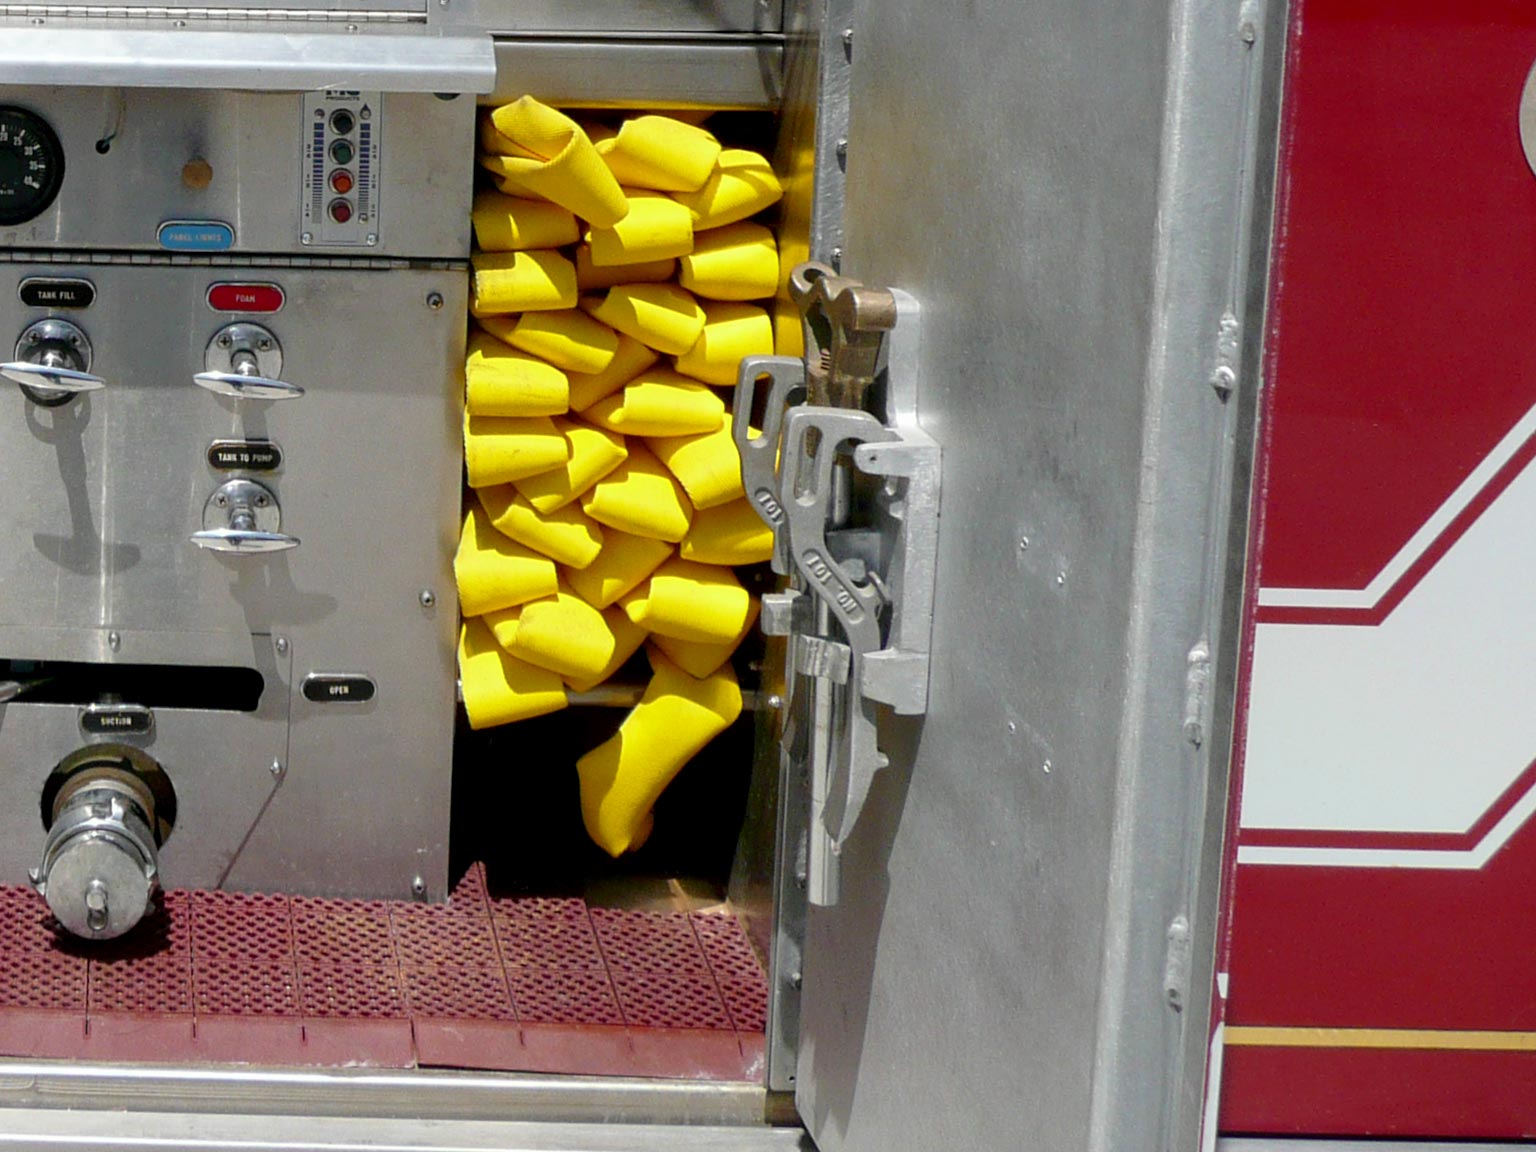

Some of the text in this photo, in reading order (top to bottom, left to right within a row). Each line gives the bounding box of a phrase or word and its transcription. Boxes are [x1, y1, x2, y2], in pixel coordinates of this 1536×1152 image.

[0, 132, 8, 141] 20
[13, 136, 22, 146] 25
[24, 146, 33, 156] 30
[29, 160, 38, 170] 35
[37, 290, 75, 300] TANK FILL
[235, 294, 256, 303] FOAM
[218, 452, 273, 462] TANK TO PUMP
[329, 685, 349, 695] OPEN
[101, 716, 132, 726] SUCTION
